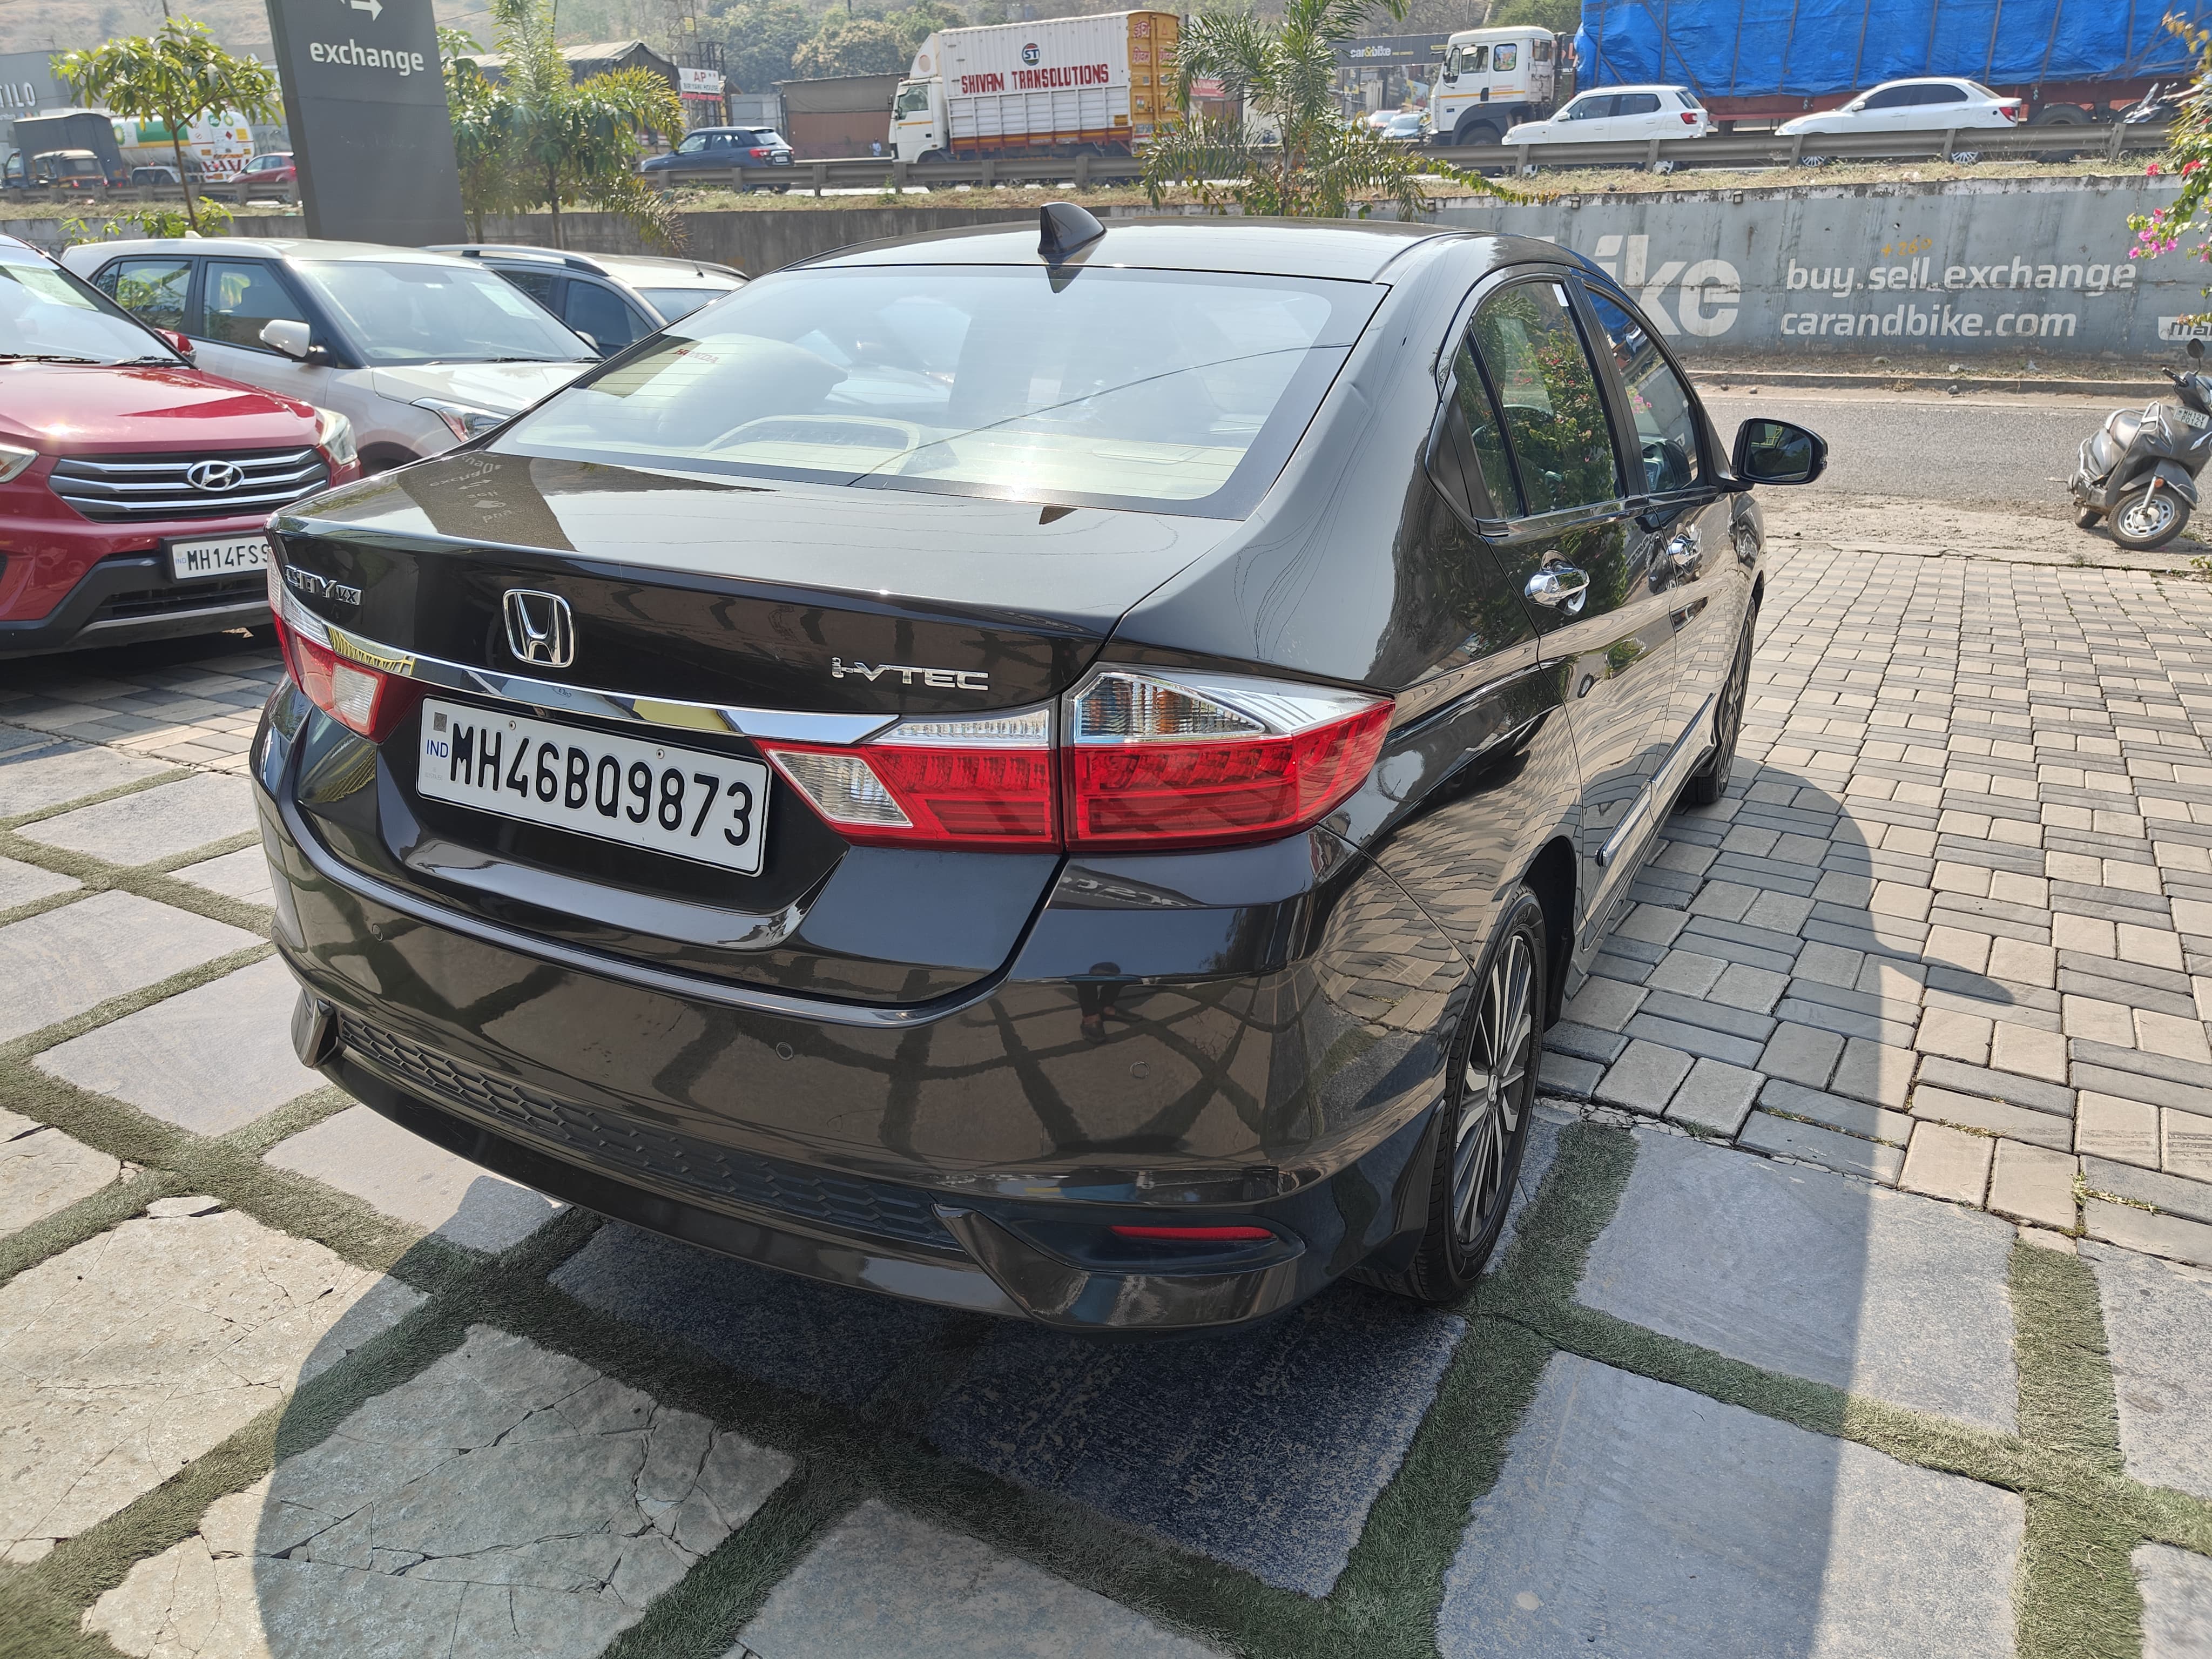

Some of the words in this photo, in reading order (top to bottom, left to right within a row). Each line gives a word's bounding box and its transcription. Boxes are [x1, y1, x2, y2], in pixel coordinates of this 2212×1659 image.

[309, 39, 424, 76] exchange
[1024, 49, 1039, 59] ST
[1350, 45, 1392, 58] car&bike
[694, 71, 706, 83] AP
[961, 72, 1004, 94] SHIVAM
[1011, 64, 1109, 90] TRANSOLUTIONS
[1780, 304, 2077, 336] carandbike.com
[2170, 322, 2212, 336] ma
[2183, 410, 2206, 421] MH12V
[285, 565, 338, 598] CITY
[335, 584, 362, 605] VX
[832, 657, 988, 691] i-VTEC
[427, 739, 449, 758] IND
[450, 723, 753, 847] MH46BQ9873
